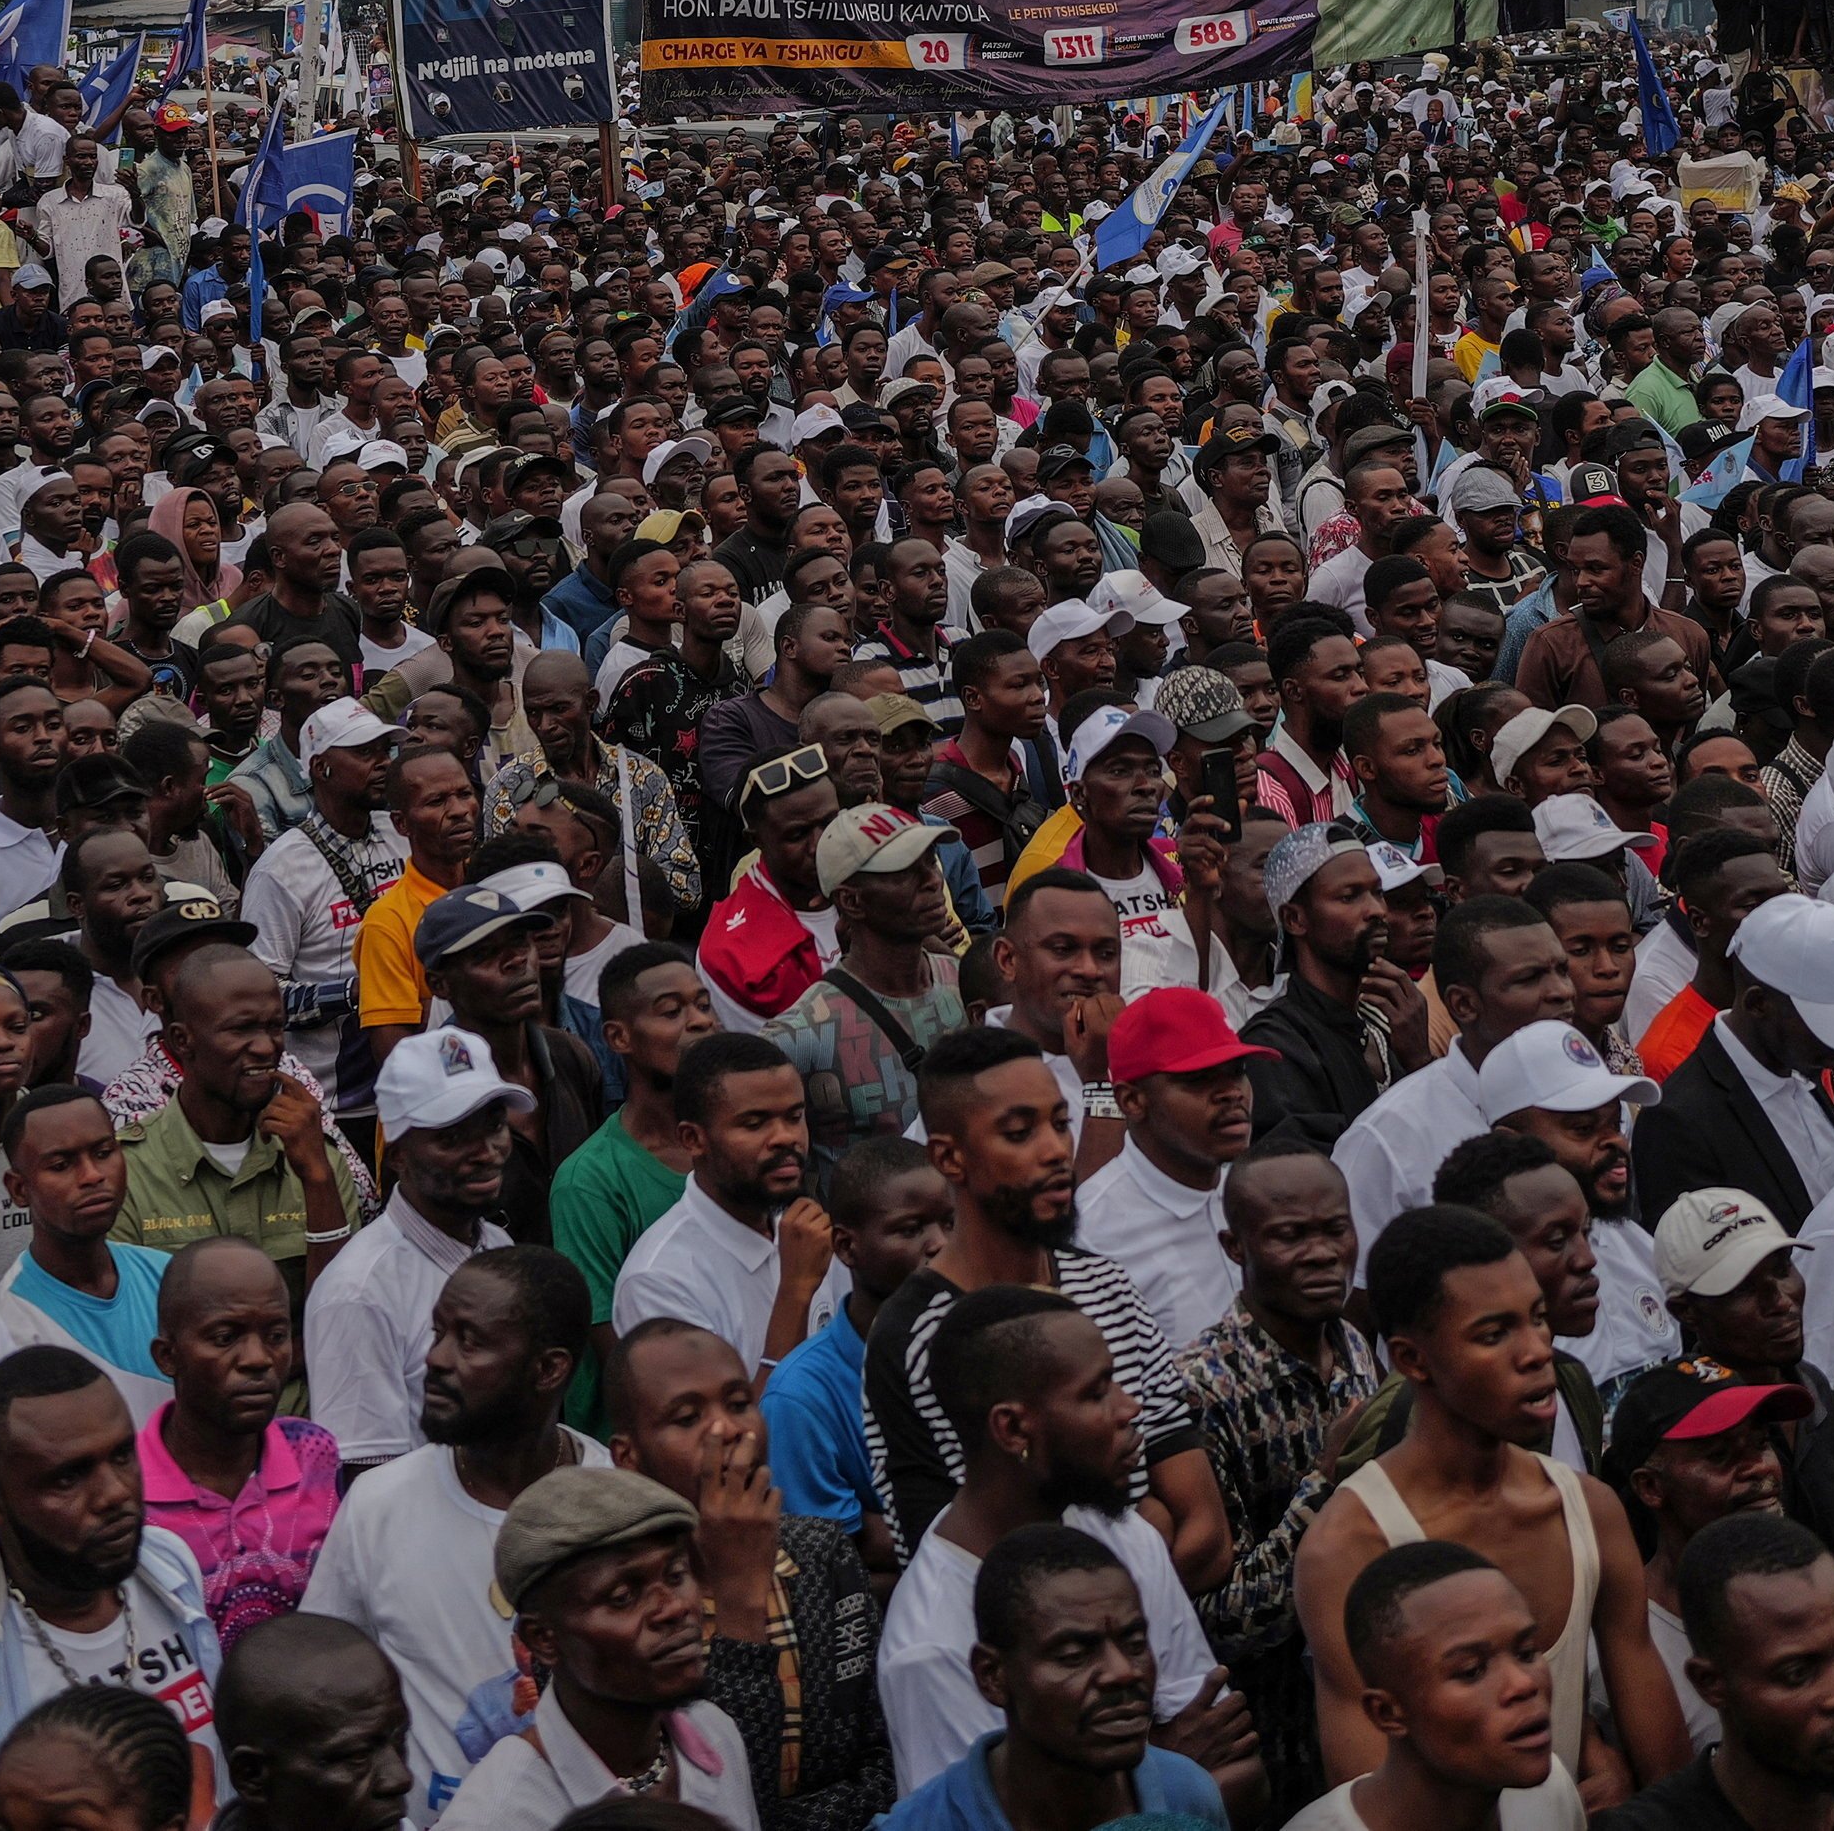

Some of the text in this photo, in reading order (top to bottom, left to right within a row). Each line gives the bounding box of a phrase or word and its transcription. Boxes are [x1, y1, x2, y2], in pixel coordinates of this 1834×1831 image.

[783, 0, 894, 23] TSHILUMBU
[899, 4, 990, 23] KANTOLA
[1189, 21, 1236, 46] 588
[741, 42, 768, 59] YA
[776, 44, 864, 61] TSHANGU
[919, 40, 950, 64] 20
[1051, 35, 1096, 59] 1311
[418, 49, 596, 82] N'djili na motema
